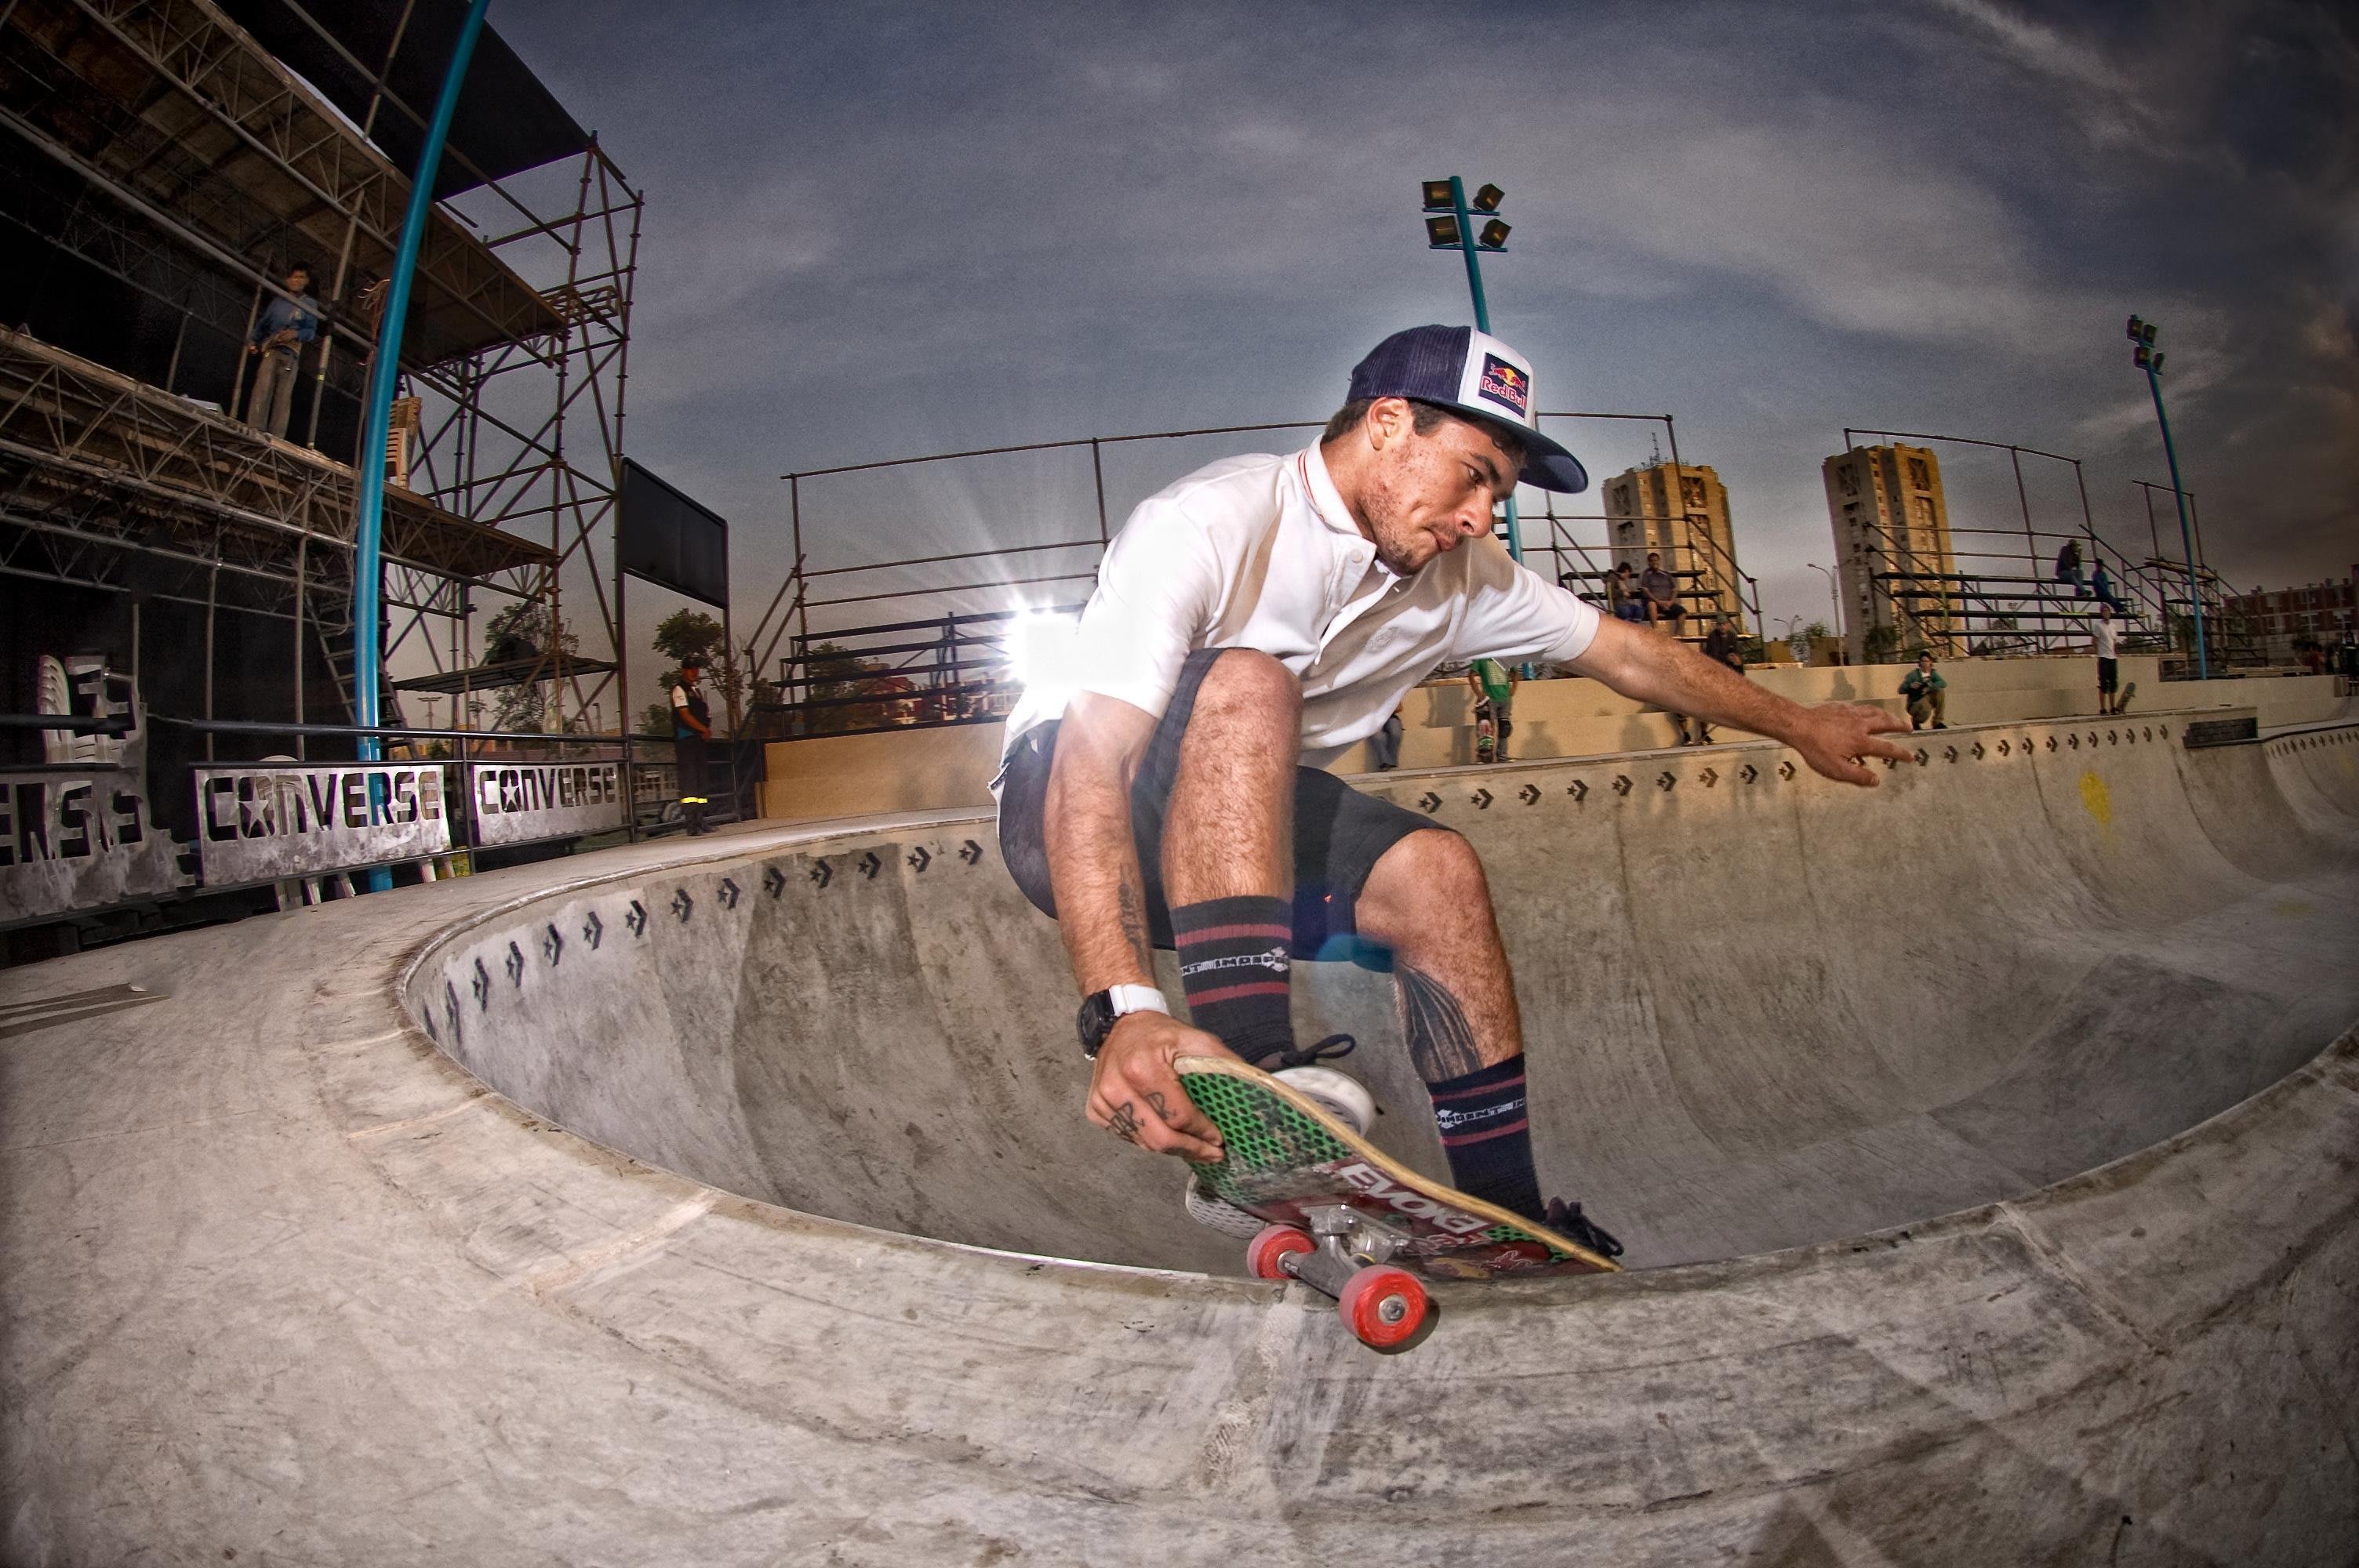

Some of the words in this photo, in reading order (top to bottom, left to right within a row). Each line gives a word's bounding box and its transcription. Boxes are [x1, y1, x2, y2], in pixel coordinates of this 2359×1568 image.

[1480, 376, 1507, 398] Red
[1507, 387, 1528, 410] Bull
[205, 771, 441, 842] CONVERSE
[480, 760, 616, 815] CONVERSE
